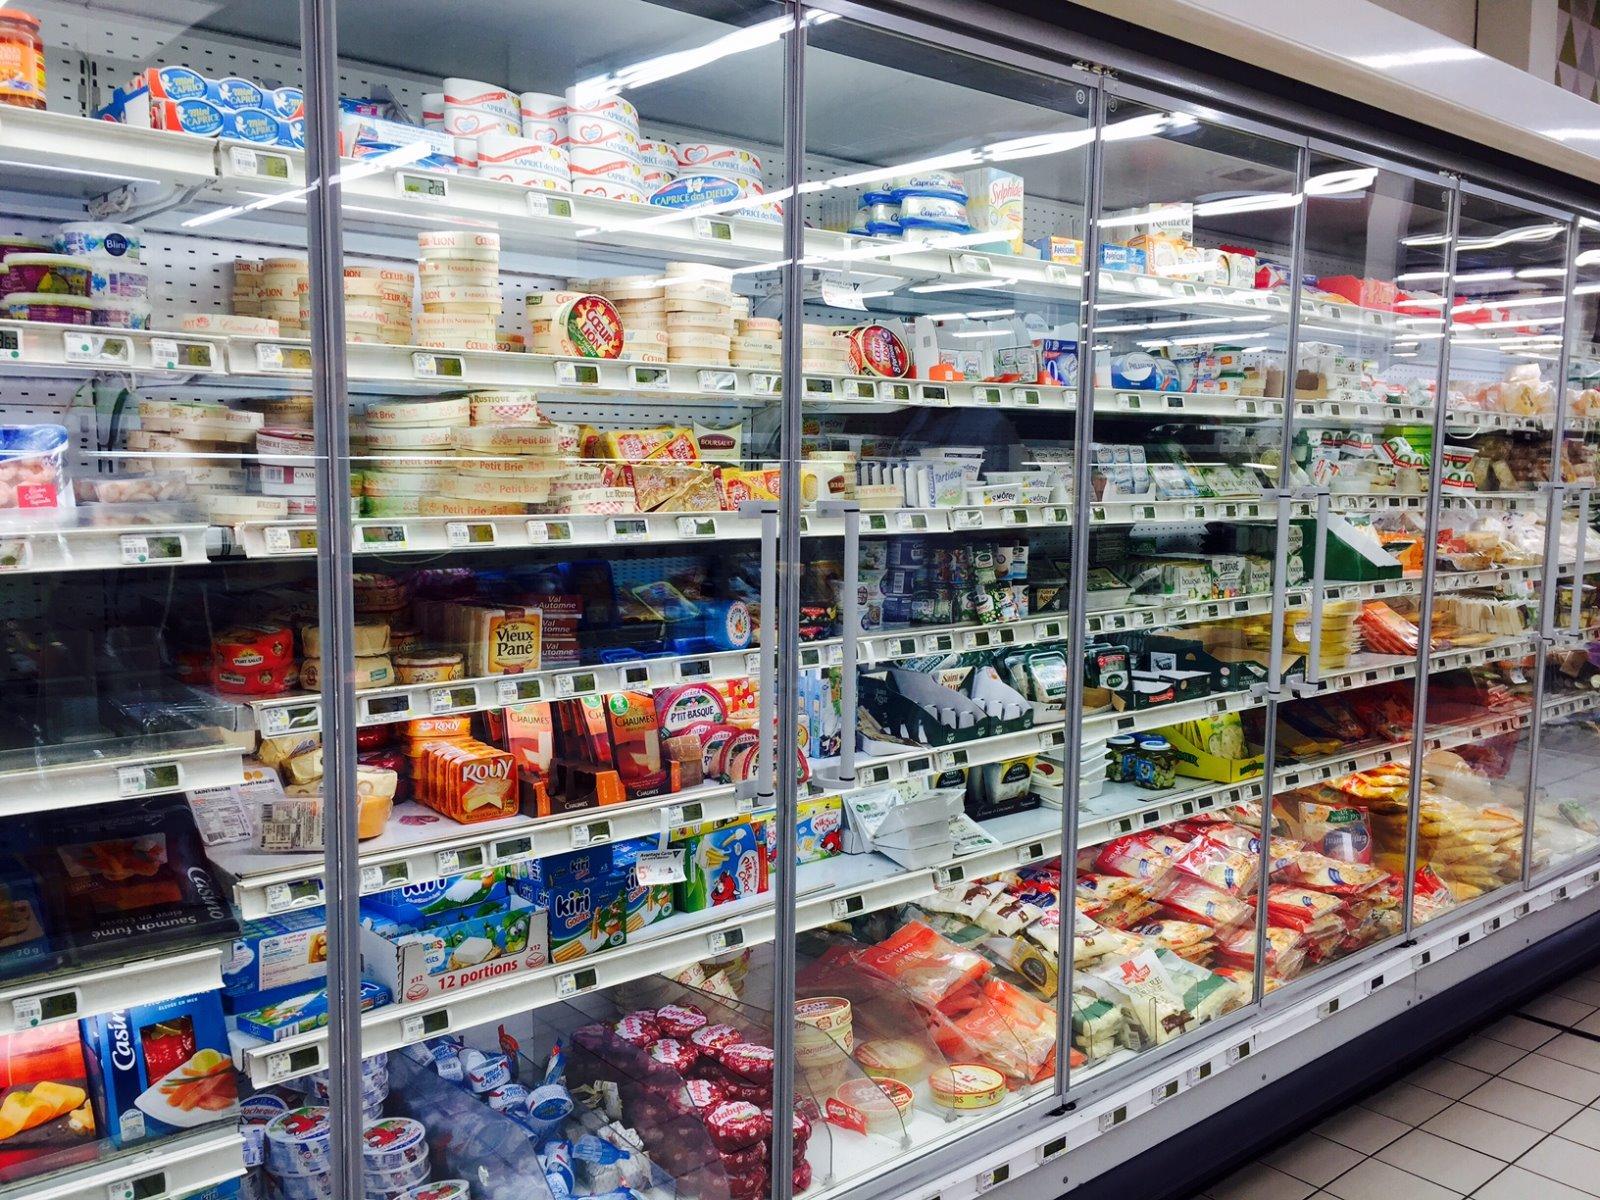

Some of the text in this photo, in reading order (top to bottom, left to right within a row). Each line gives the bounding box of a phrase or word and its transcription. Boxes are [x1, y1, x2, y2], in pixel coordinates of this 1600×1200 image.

[654, 186, 734, 207] CAPRICE des DIEUX
[106, 239, 126, 249] Blini
[586, 309, 613, 342] CŒUR
[580, 322, 602, 350] LION
[516, 436, 536, 445] Petit
[480, 462, 524, 472] Petit Brie
[500, 484, 523, 494] Petit
[443, 504, 487, 515] Petit Brie
[548, 595, 562, 603] Val
[496, 629, 534, 642] Vieux
[497, 642, 533, 657] Pané
[670, 706, 714, 723] P'TIT BASQUE
[462, 758, 513, 784] ROUY
[187, 866, 225, 920] Casino
[556, 888, 591, 918] kiri
[92, 916, 197, 940] Saumon fumé
[530, 944, 541, 952] x12
[411, 974, 424, 984] x12
[438, 959, 518, 990] 12 portions
[107, 1010, 136, 1071] Casin
[713, 1102, 754, 1124] Babybel
